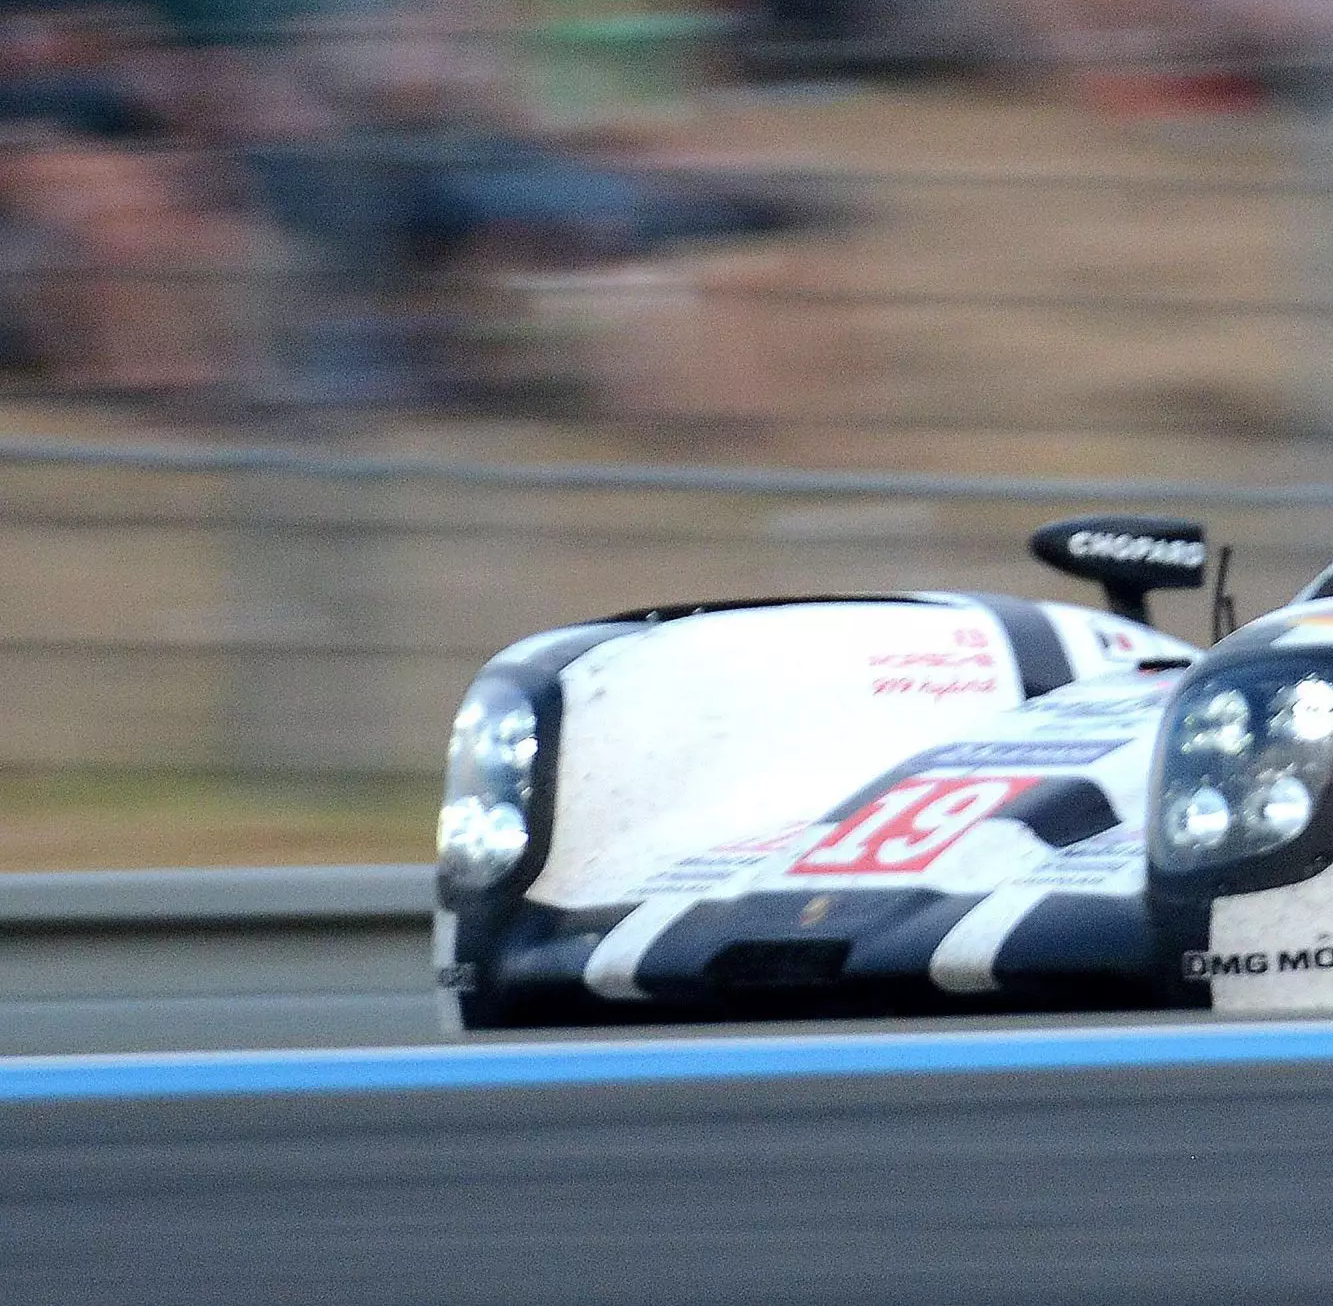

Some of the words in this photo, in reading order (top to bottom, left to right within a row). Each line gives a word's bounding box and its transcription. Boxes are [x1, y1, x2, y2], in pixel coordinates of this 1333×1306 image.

[1068, 530, 1206, 567] CHOPARD
[800, 779, 1008, 866] 19
[1185, 950, 1268, 978] DMG
